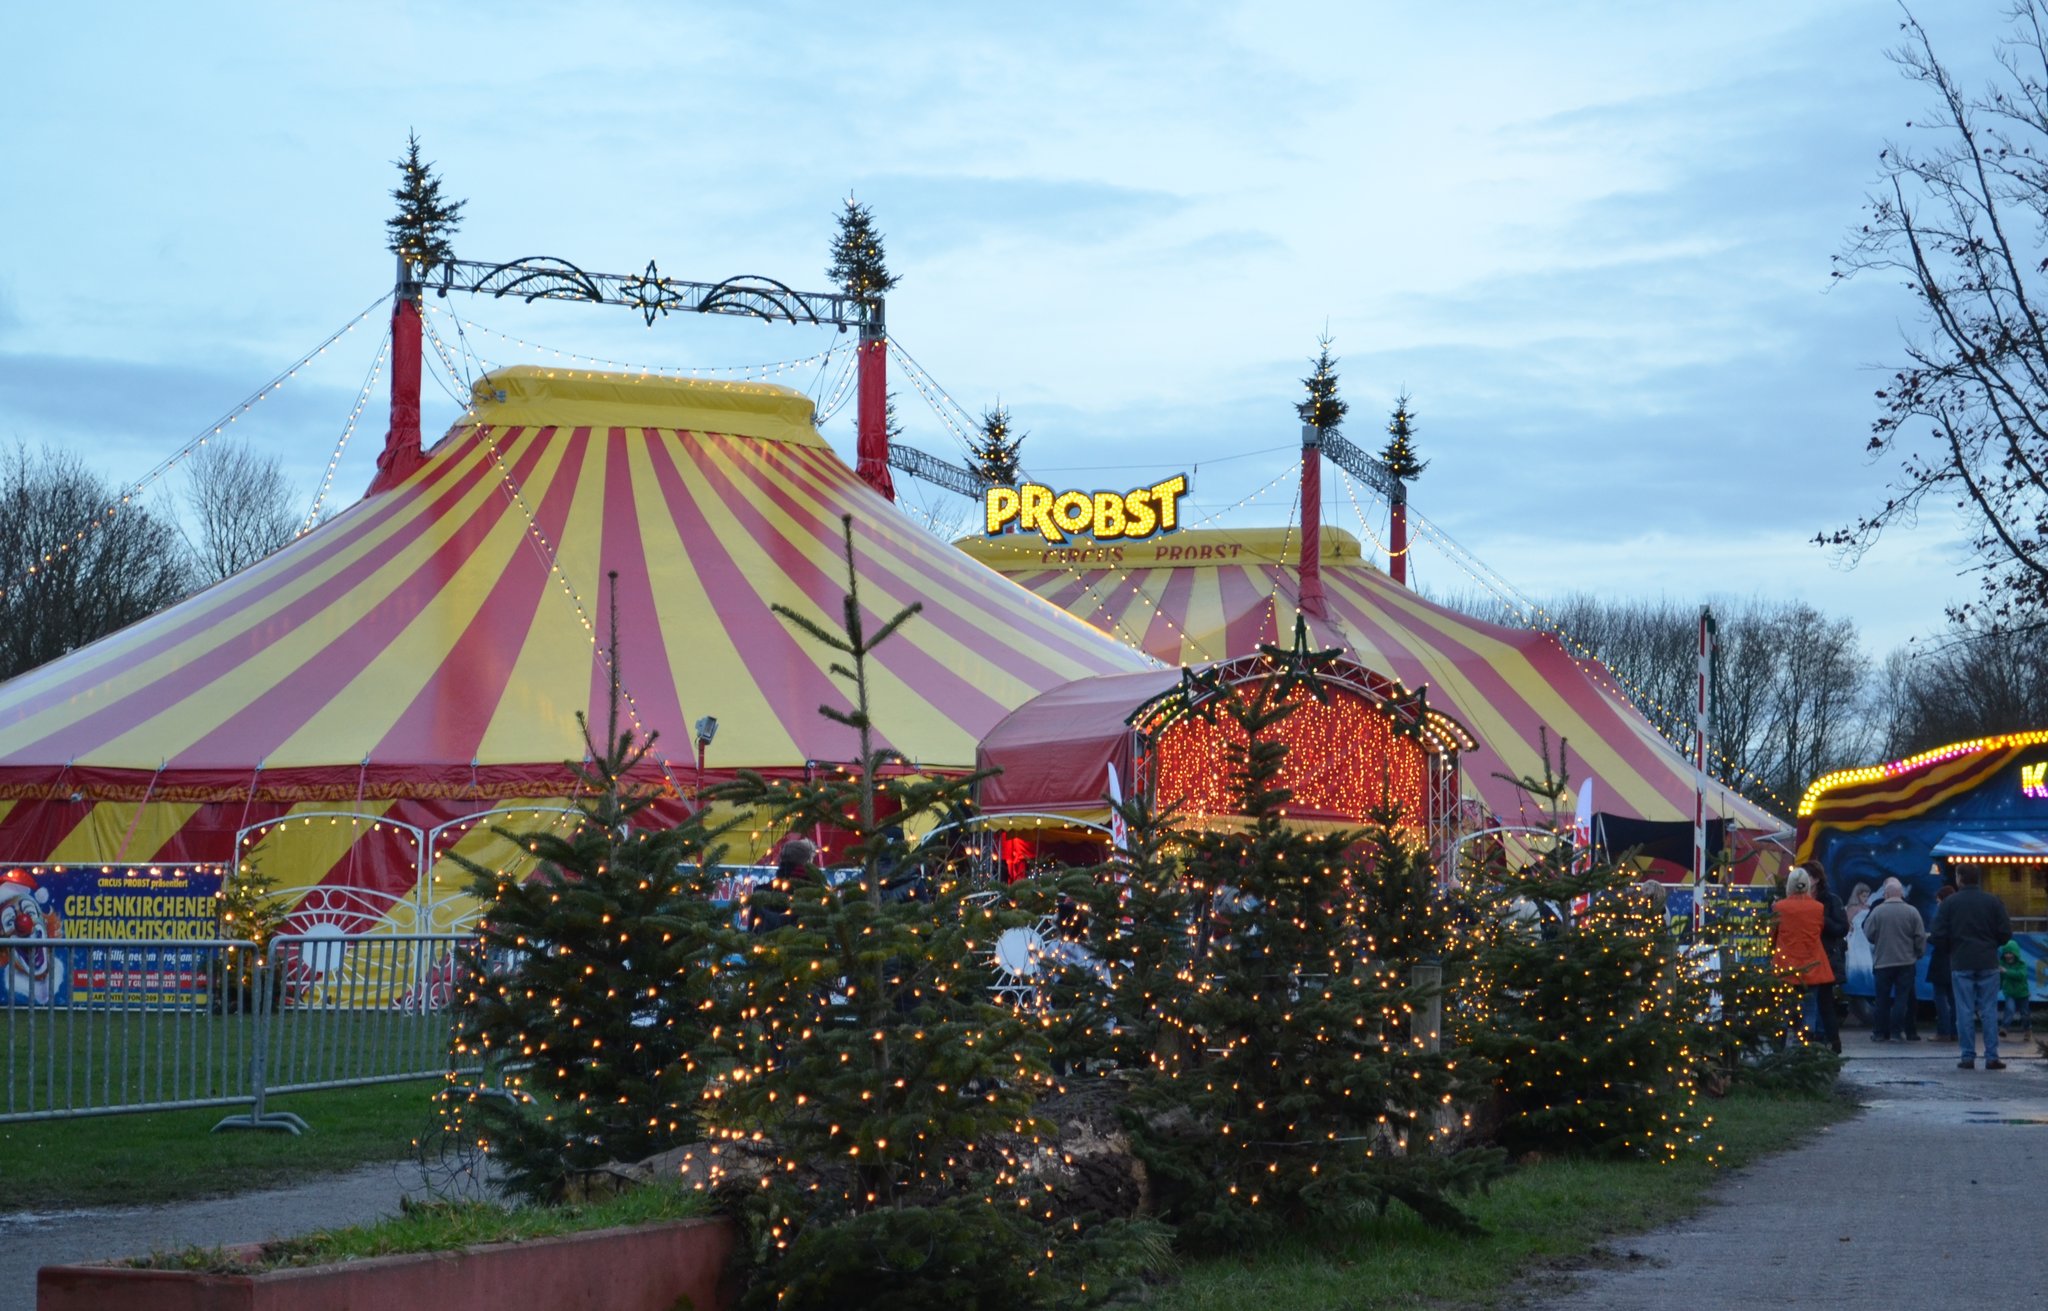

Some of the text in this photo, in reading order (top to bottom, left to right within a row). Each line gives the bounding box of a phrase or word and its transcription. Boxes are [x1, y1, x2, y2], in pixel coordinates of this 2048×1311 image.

[986, 474, 1186, 543] PROBST
[1042, 543, 1242, 563] CIRCUS PROBST
[98, 878, 188, 889] CIRCUS PROBST präsentiert
[64, 896, 217, 918] GELSENKIRCHENER
[64, 919, 216, 941] WEIHNACHTSCIRCUS
